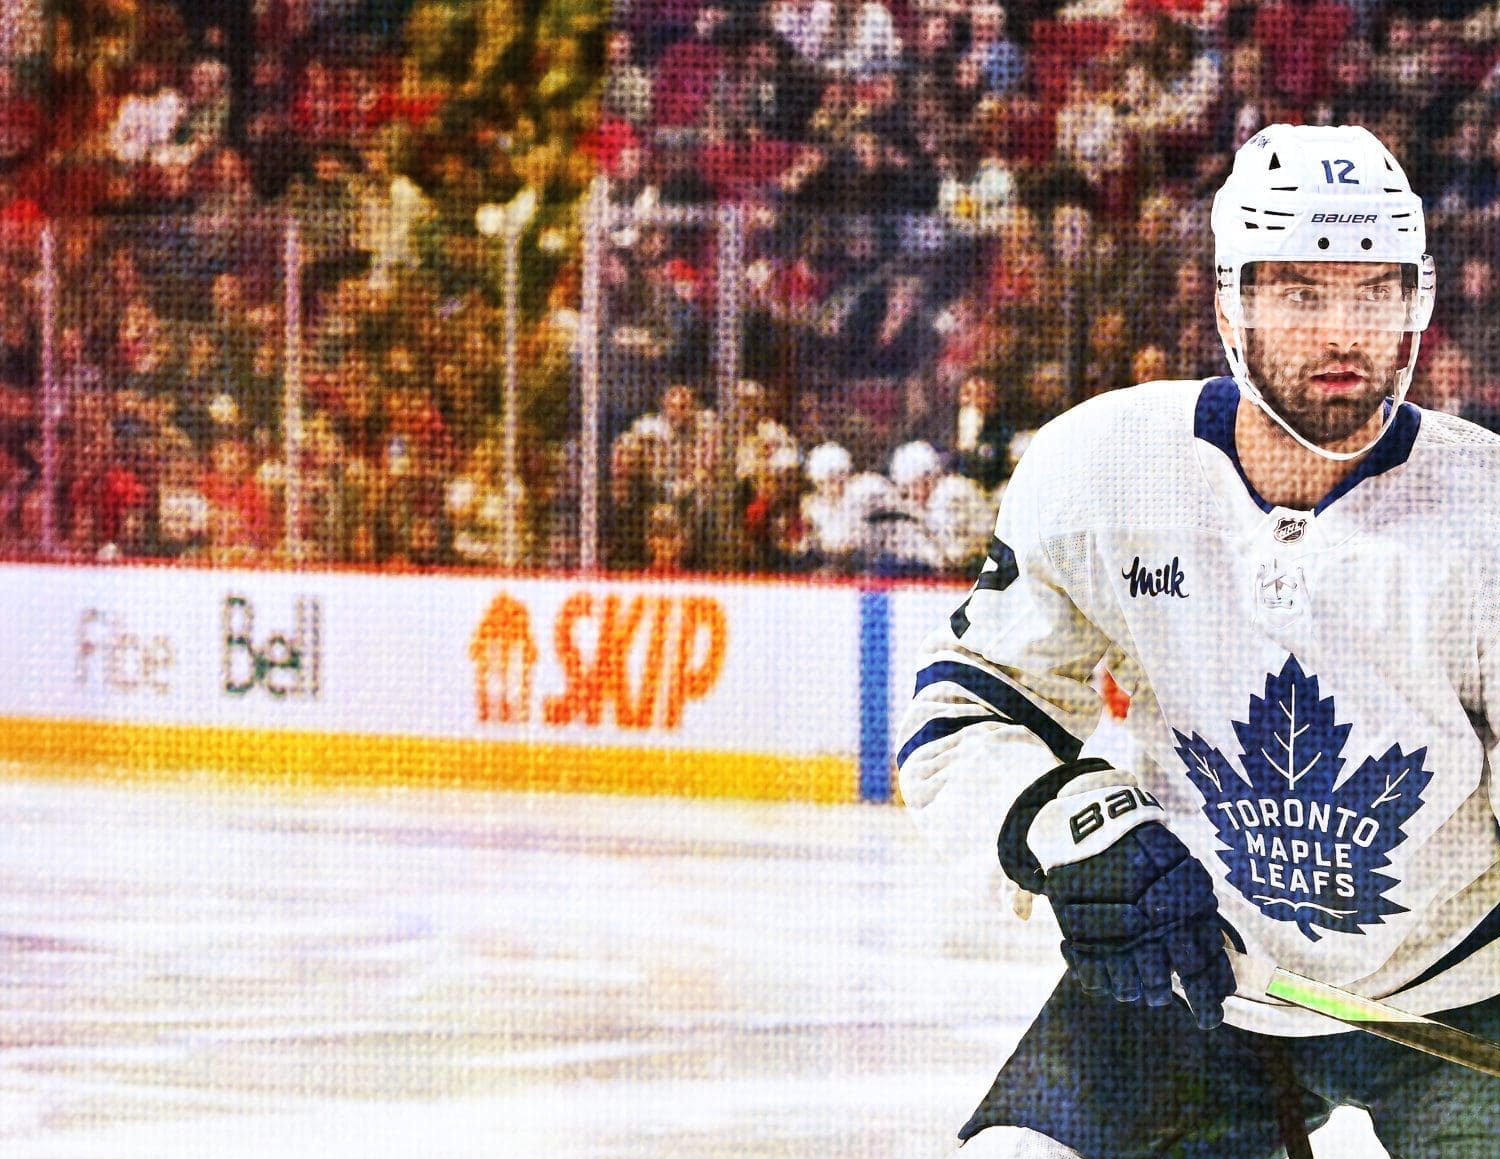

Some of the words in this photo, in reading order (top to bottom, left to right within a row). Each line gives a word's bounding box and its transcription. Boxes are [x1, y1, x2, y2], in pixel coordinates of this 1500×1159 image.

[1320, 158, 1360, 185] 12
[1310, 212, 1378, 225] BAUER
[1121, 556, 1190, 598] Milk
[222, 592, 322, 698] Bell
[543, 591, 729, 730] SKIP
[1217, 798, 1380, 848] TORONTO
[1245, 830, 1353, 869] MAPLE
[1250, 859, 1355, 898] LEAFS
